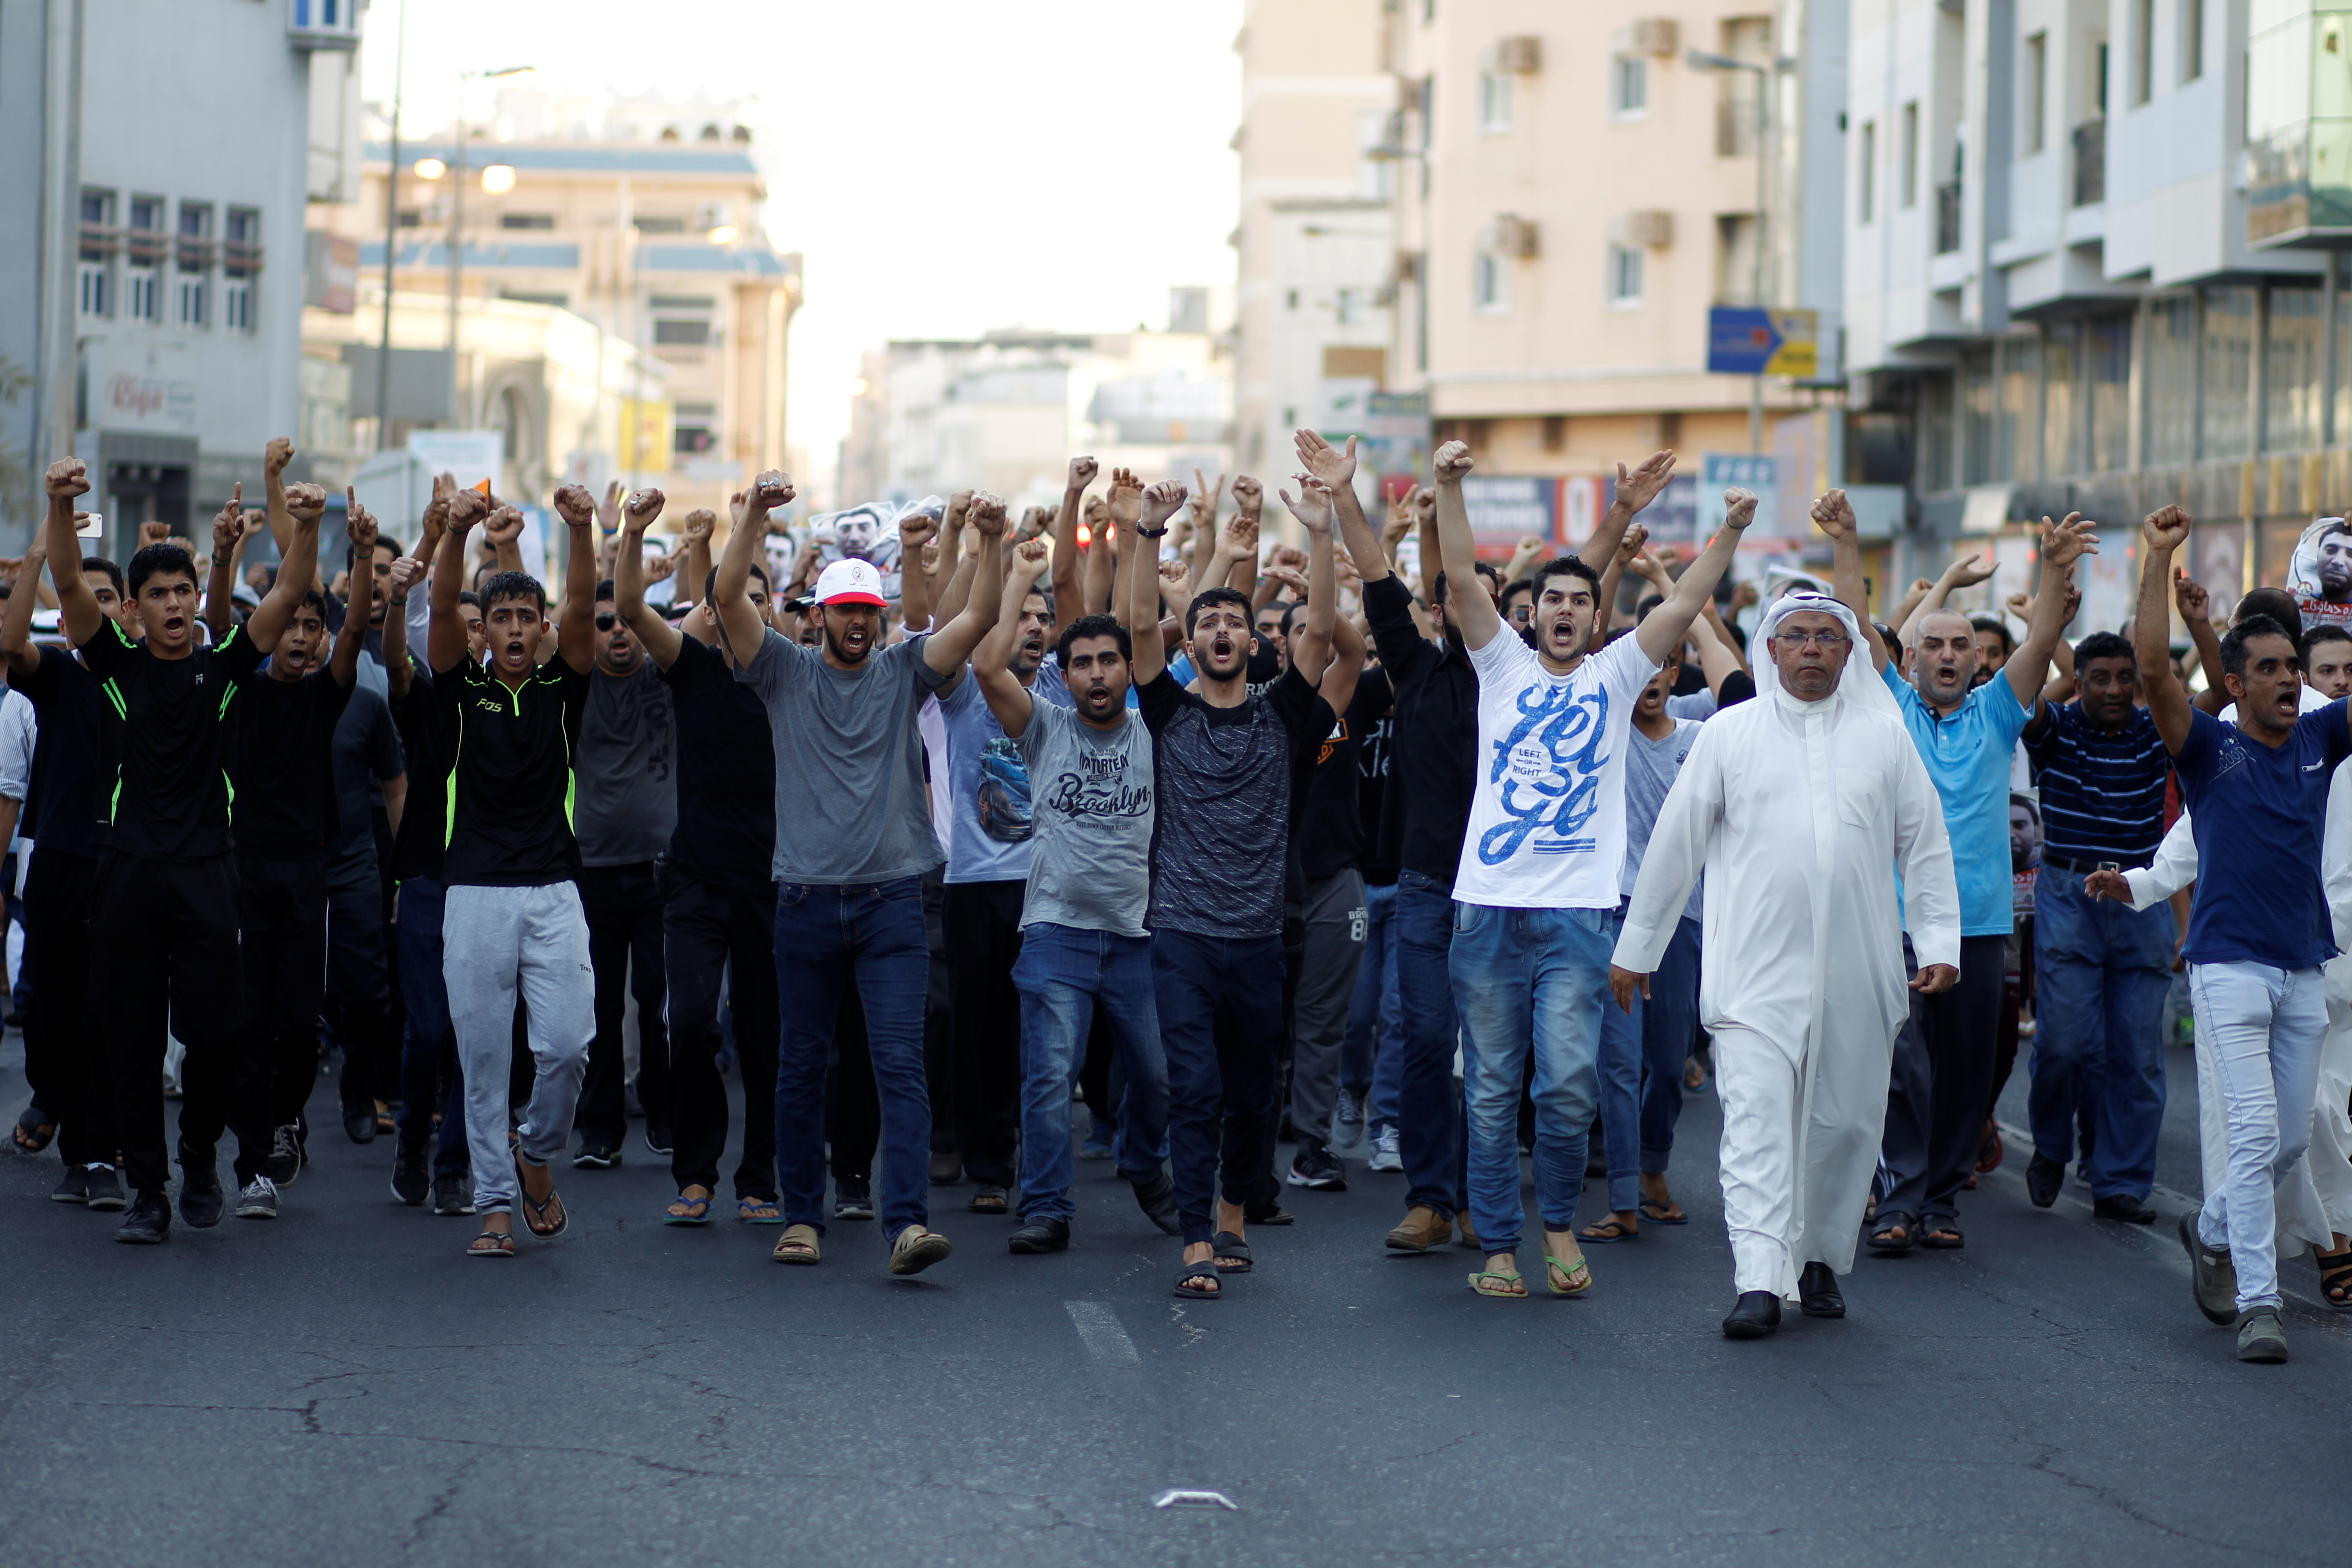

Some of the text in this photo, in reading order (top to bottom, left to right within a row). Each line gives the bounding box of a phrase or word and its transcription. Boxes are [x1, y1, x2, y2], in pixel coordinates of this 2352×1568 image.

[1519, 748, 1542, 759] LEFT
[1512, 765, 1542, 777] RIGHT
[1049, 772, 1152, 819] Brooklyn
